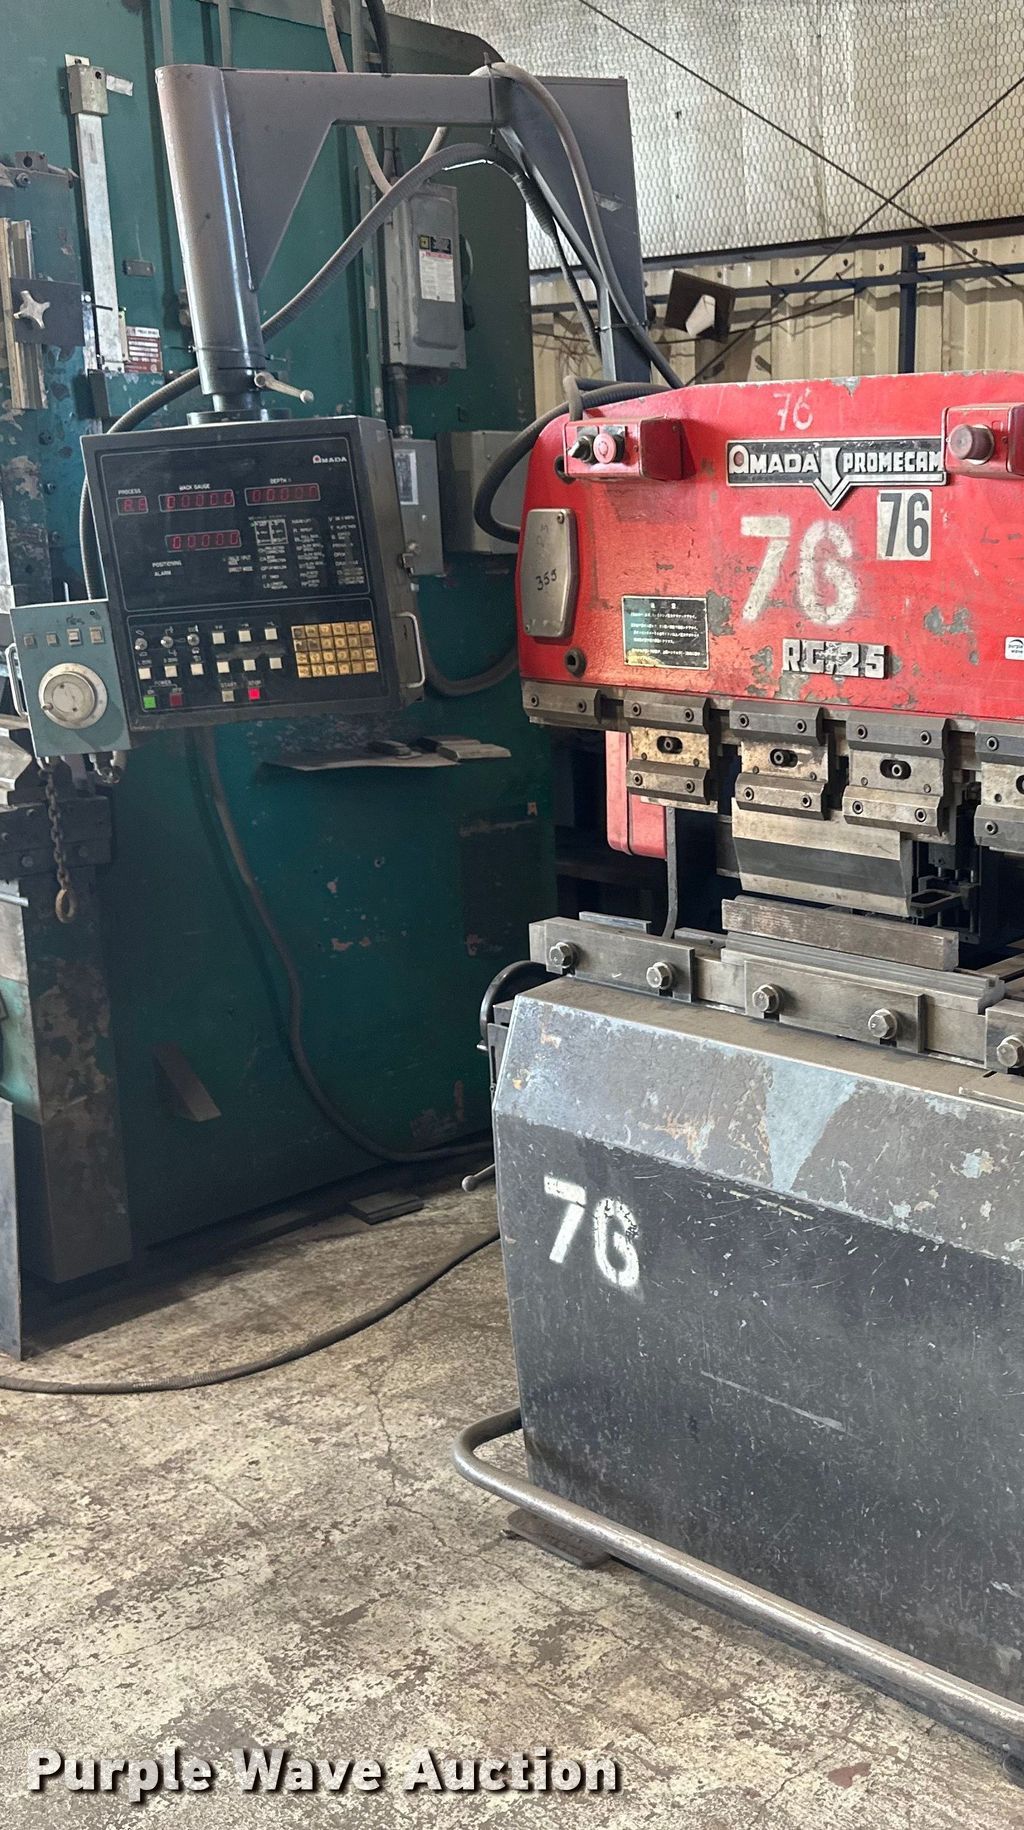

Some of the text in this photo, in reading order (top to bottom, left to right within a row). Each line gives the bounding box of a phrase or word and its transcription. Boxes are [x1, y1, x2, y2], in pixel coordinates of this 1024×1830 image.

[772, 387, 814, 432] 76
[843, 451, 943, 473] PROMECAM
[880, 492, 930, 557] 76
[740, 515, 860, 625] 76
[543, 1175, 640, 1287] 76
